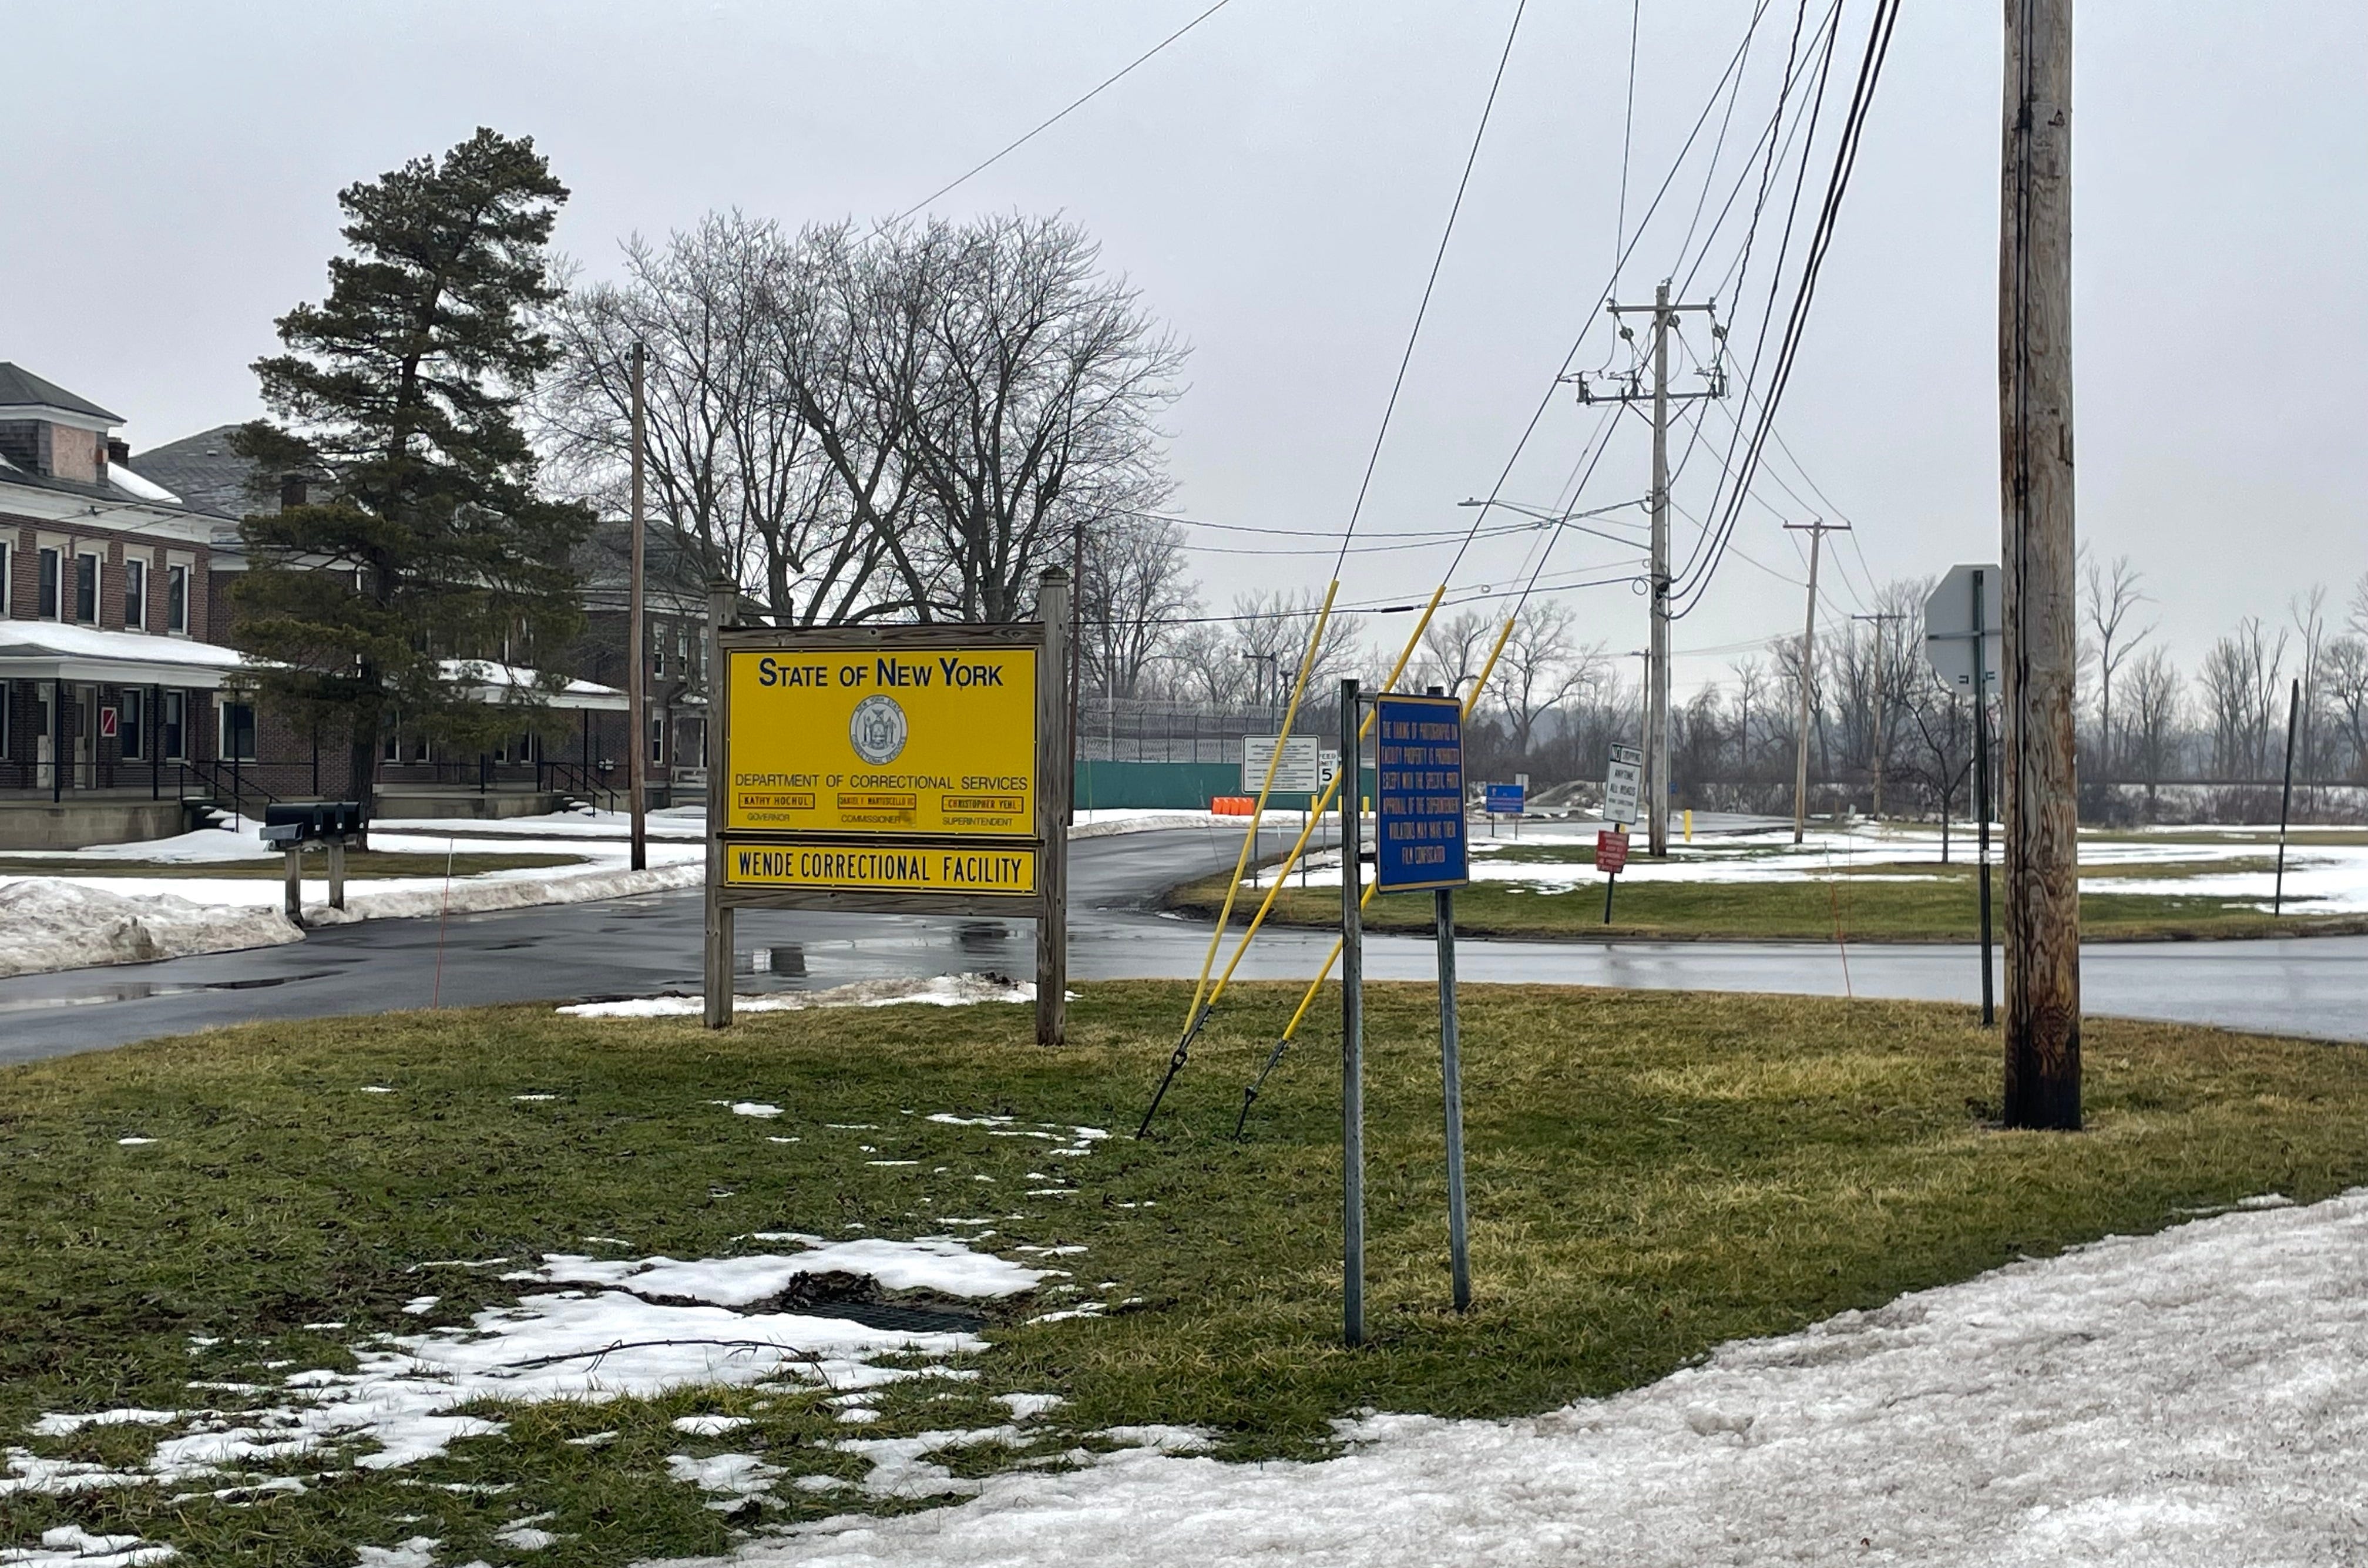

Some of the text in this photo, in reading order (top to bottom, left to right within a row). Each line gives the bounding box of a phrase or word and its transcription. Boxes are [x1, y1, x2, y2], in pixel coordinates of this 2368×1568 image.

[759, 657, 1003, 687] STATE OF NEW YORK
[735, 774, 1027, 790] DEPARTMENT OF CORRECTIONAL SERVICES
[744, 796, 808, 805] KATHY HOCHUL
[948, 800, 995, 809] CHRISTOPHER
[747, 812, 790, 821] GOVERNOR
[841, 814, 901, 824] COMMISSIONER
[942, 817, 1013, 826] SUPERINTENDENT
[739, 852, 1022, 884] WENDE CORRECTIONAL FACILITY
